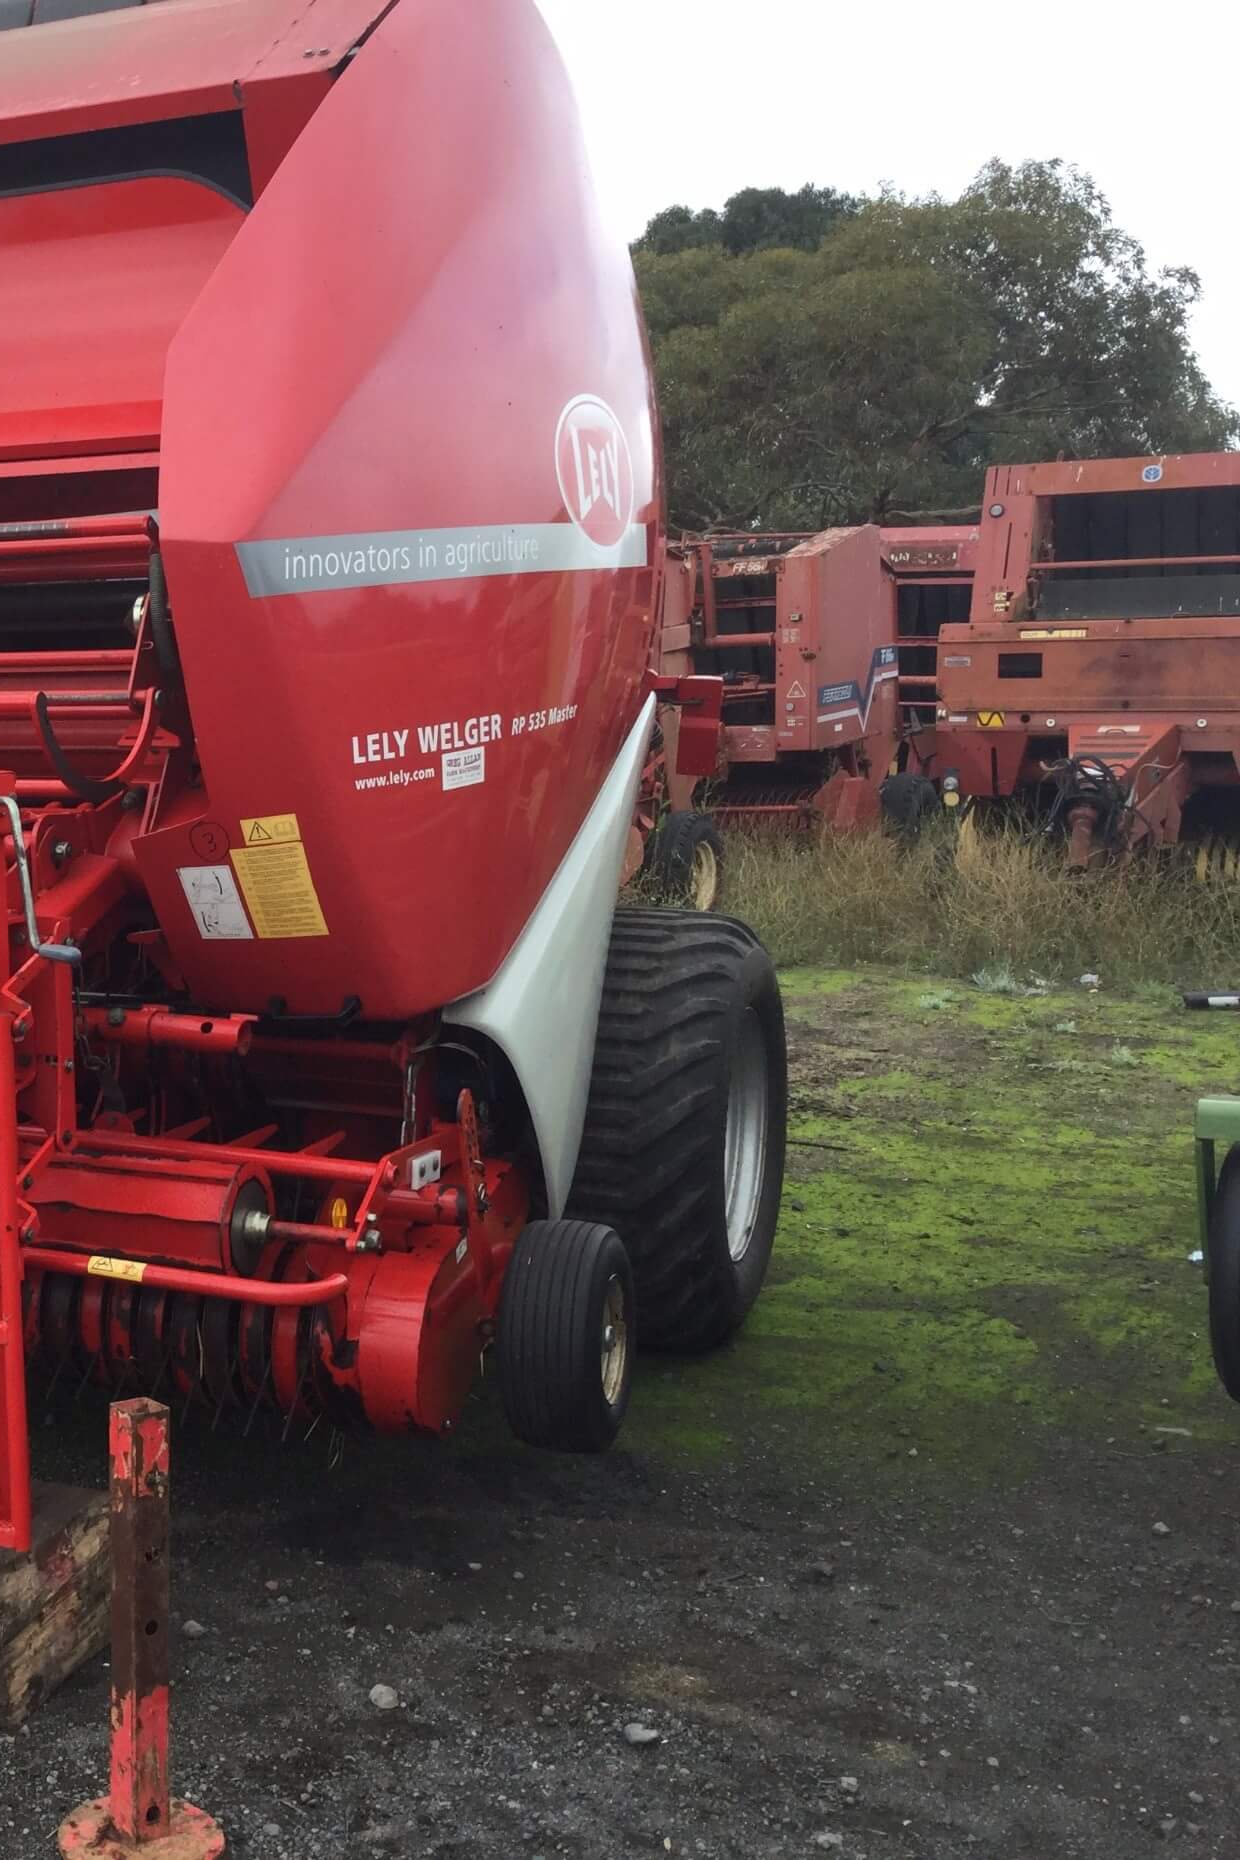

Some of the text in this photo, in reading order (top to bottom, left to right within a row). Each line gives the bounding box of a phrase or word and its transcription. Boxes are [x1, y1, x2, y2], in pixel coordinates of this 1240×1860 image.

[569, 423, 621, 520] LELY
[284, 533, 540, 579] innovators in agriculture
[352, 714, 502, 764] LELY WELGER
[511, 703, 578, 736] RP 535 Master
[355, 767, 435, 791] www.lely.com
